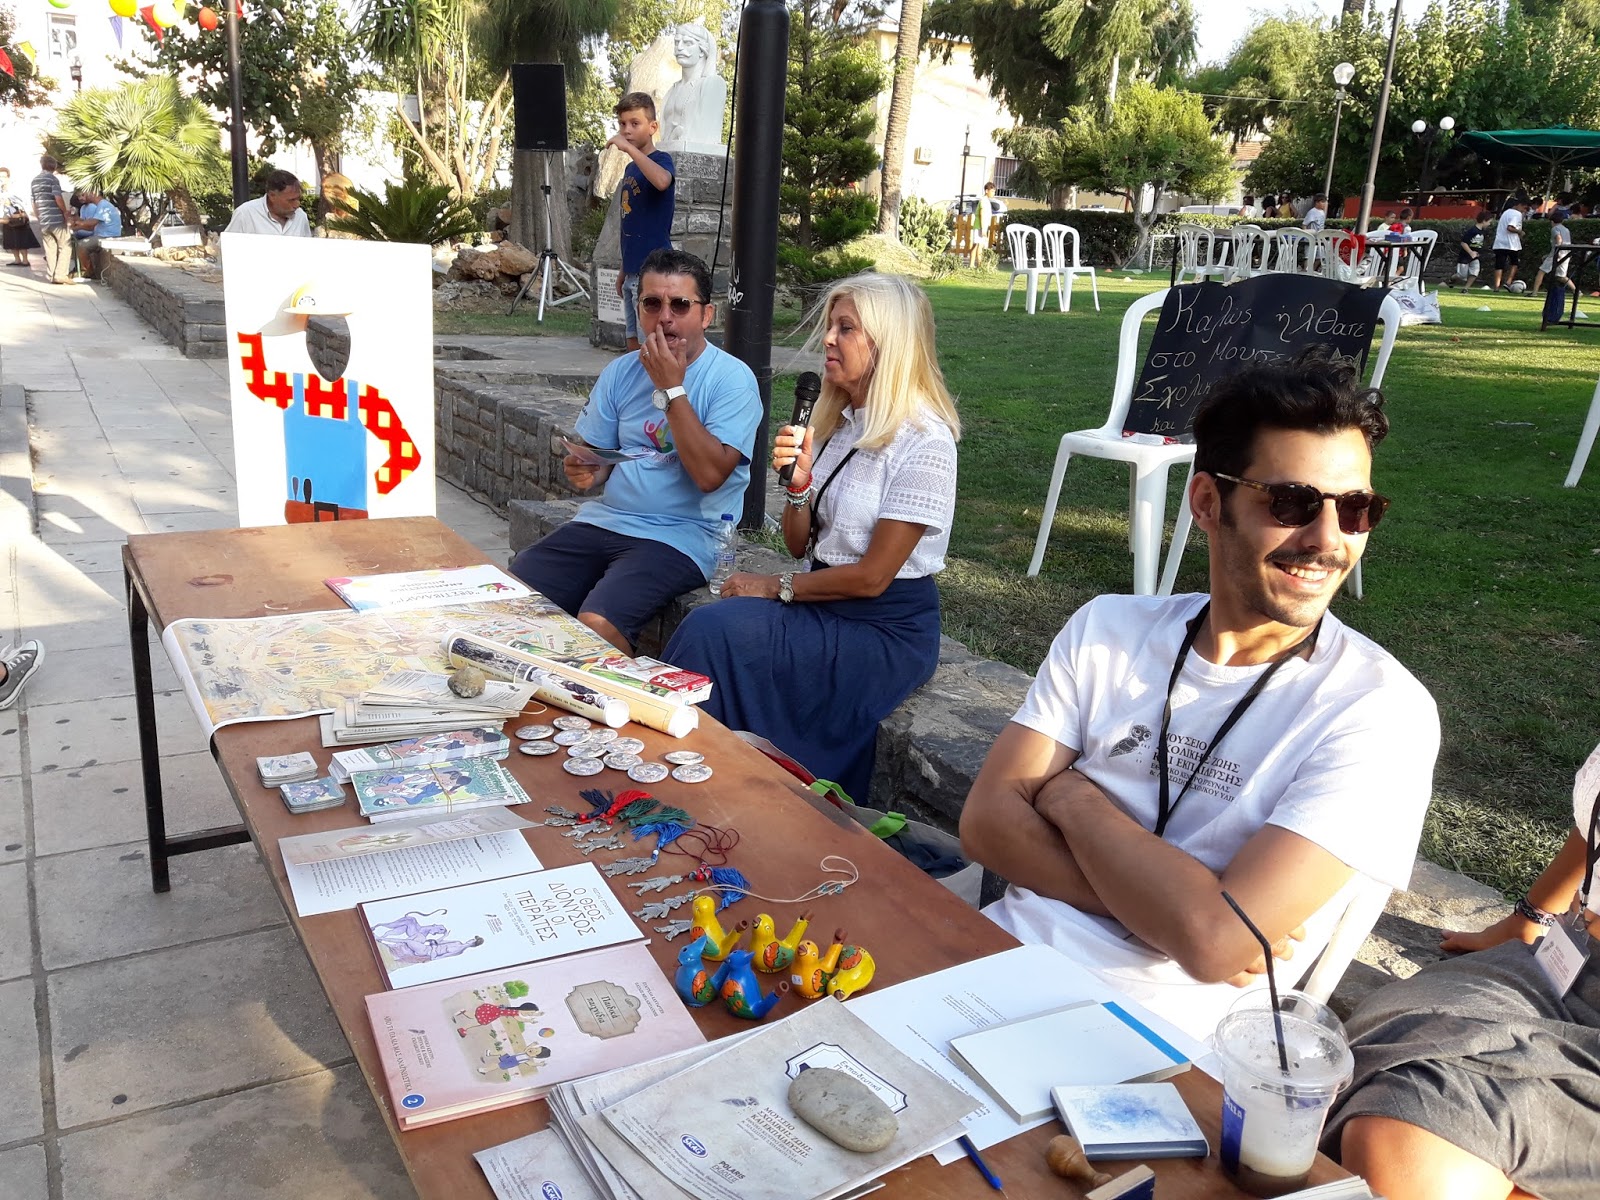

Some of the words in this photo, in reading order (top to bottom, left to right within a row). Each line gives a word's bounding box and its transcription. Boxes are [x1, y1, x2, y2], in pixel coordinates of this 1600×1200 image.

[1151, 351, 1196, 368] στο
[1208, 336, 1292, 367] Μουσε
[1134, 374, 1211, 411] Σχολικ
[1150, 417, 1175, 432] και
[1153, 751, 1173, 764] ΚΙ
[1211, 757, 1240, 774] ΖΩΗΣ
[573, 887, 587, 895] Ο
[514, 890, 558, 942] ΠΕΙΡΑΤΕΣ
[540, 898, 559, 914] ΚΑΙ
[551, 915, 567, 926] ΟΙ
[548, 883, 596, 936] ΔΙΟΝΥΣΟΣ
[579, 897, 605, 922] ΘΕΟΣ
[407, 1097, 419, 1105] 2
[757, 1110, 791, 1138] ΣΧΟΛΙΚΗΣ
[790, 1136, 813, 1152] ΖΩΗΣ
[763, 1107, 795, 1131] ΜΟΥΣΕΙΟ
[683, 1137, 704, 1155] SKAG
[751, 1114, 764, 1125] ΚΑΙ
[763, 1123, 810, 1159] ΕΚΠΑΙΔΕΥΣΗΣ
[719, 1160, 746, 1180] POLARIS
